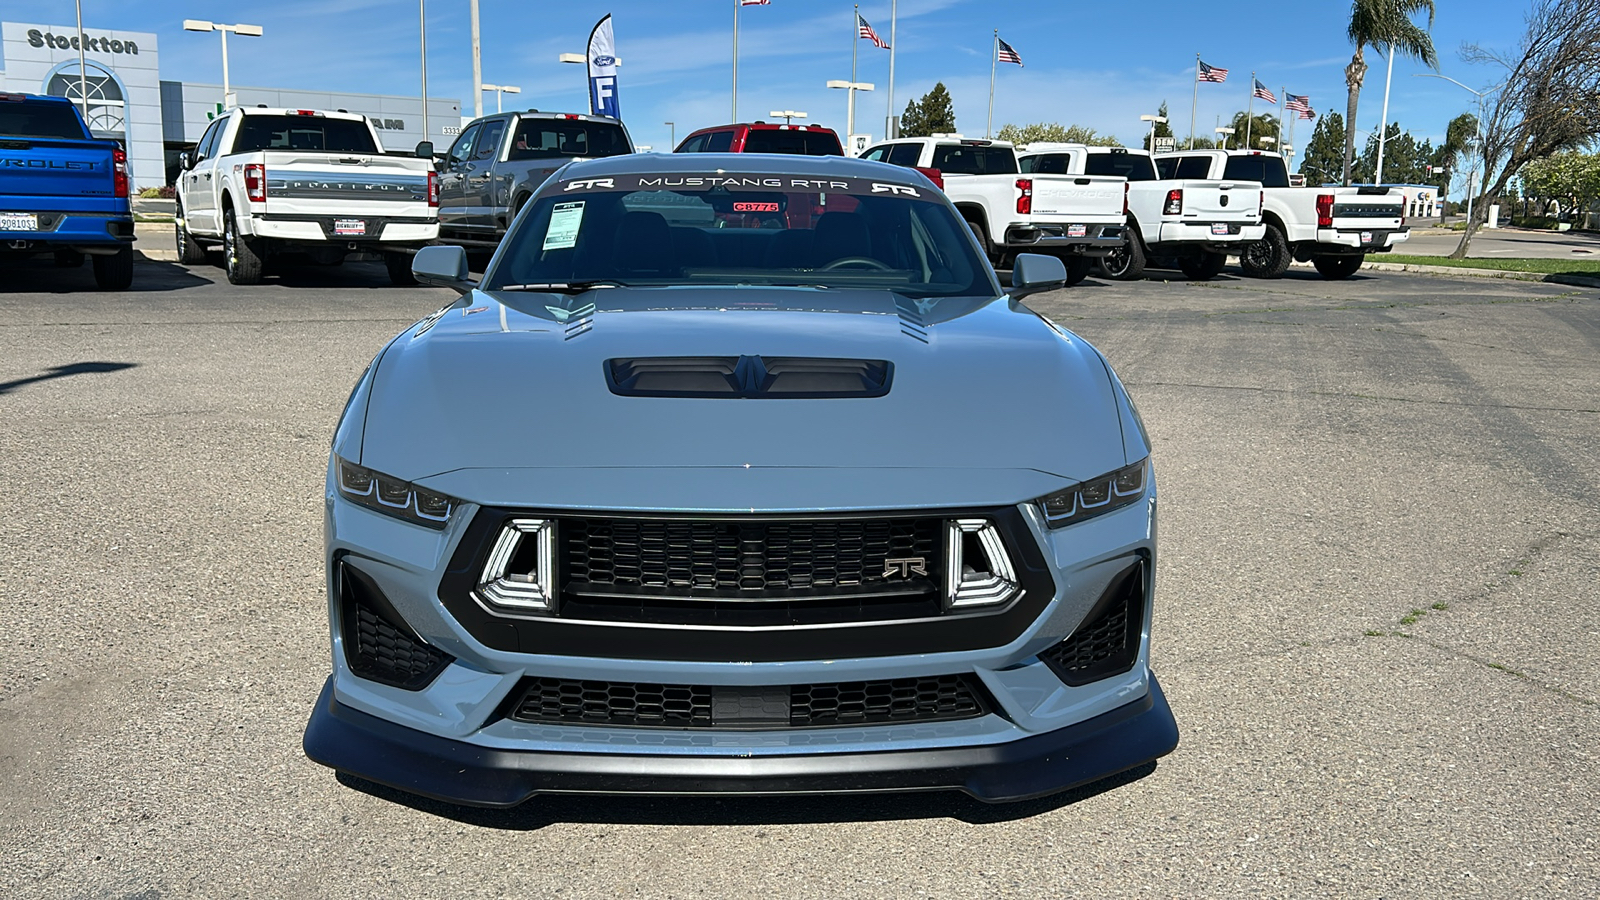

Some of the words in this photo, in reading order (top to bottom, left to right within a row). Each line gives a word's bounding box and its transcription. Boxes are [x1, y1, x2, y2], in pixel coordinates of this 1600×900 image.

[27, 29, 139, 55] Stockton
[596, 77, 614, 110] F
[1155, 138, 1174, 146] OEM
[0, 159, 101, 170] ROLET
[294, 181, 405, 191] PLATINUM
[638, 177, 782, 187] MUSTANG
[791, 179, 849, 190] RTR
[1039, 189, 1120, 199] CHEVROLET
[734, 203, 778, 212] C8775
[1, 219, 36, 229] 90810S3
